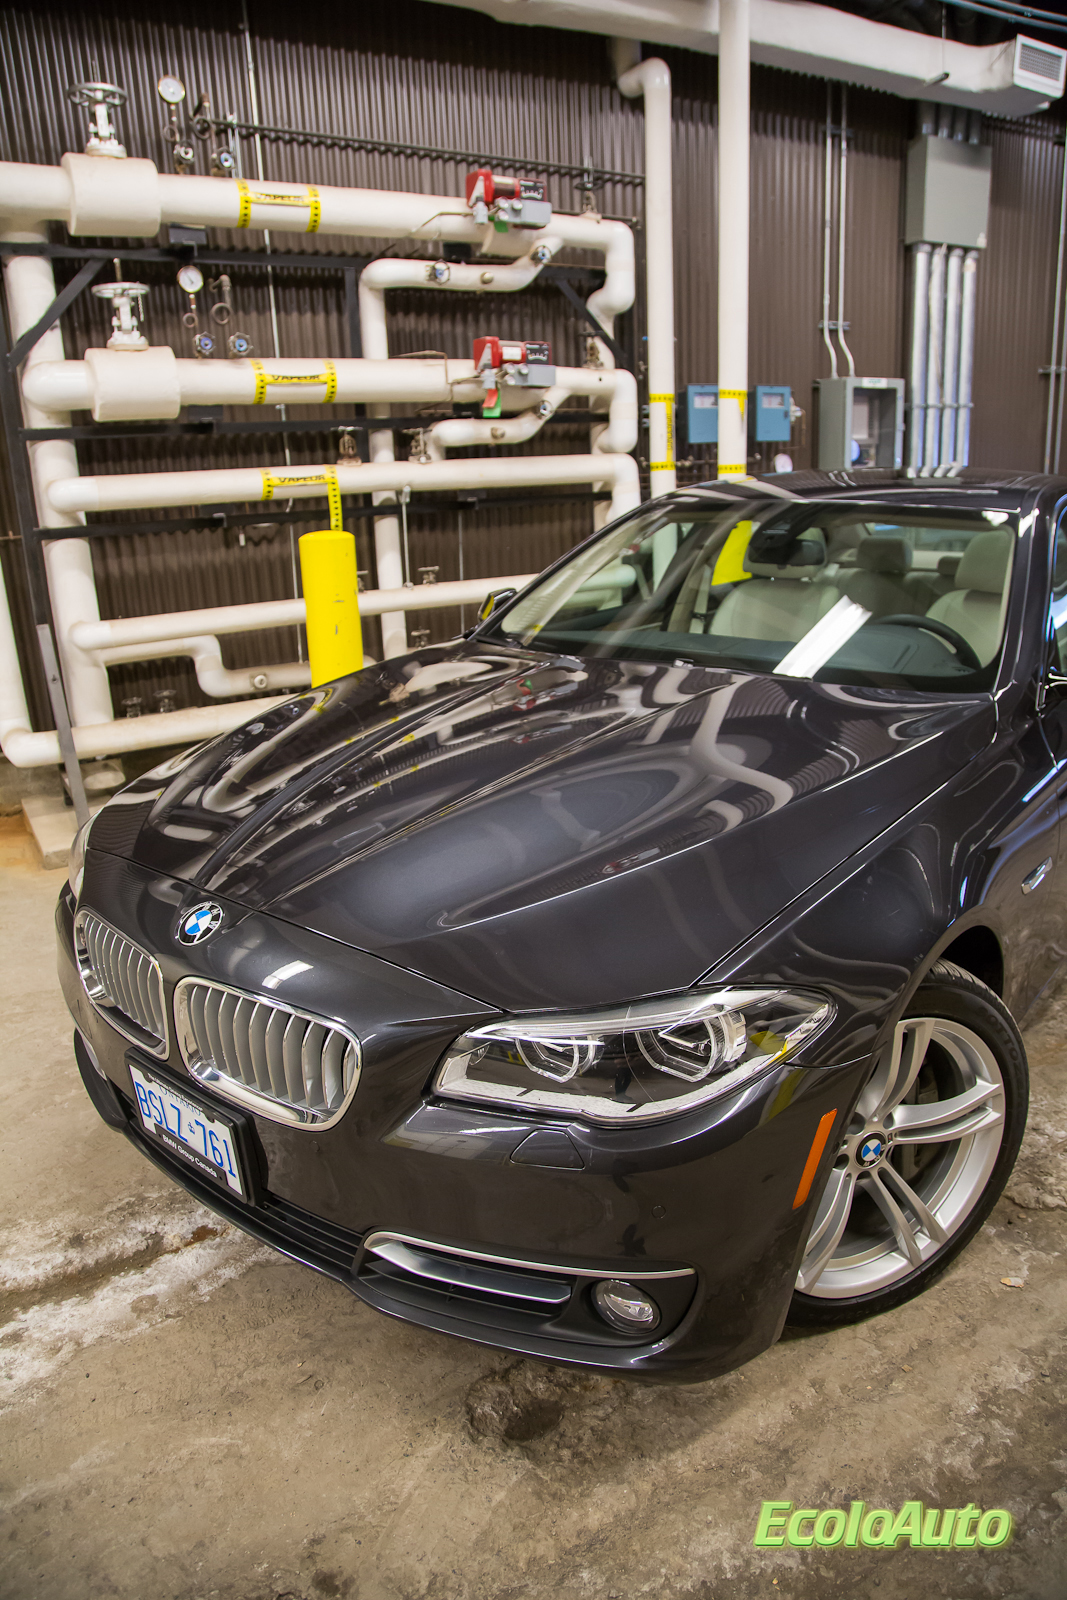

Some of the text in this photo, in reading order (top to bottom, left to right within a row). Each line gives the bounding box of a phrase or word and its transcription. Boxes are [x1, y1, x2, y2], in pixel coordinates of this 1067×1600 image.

[272, 374, 320, 382] VAPEUR
[278, 474, 326, 483] VAPEUR
[177, 1145, 195, 1162] Group
[195, 1157, 218, 1178] Canada
